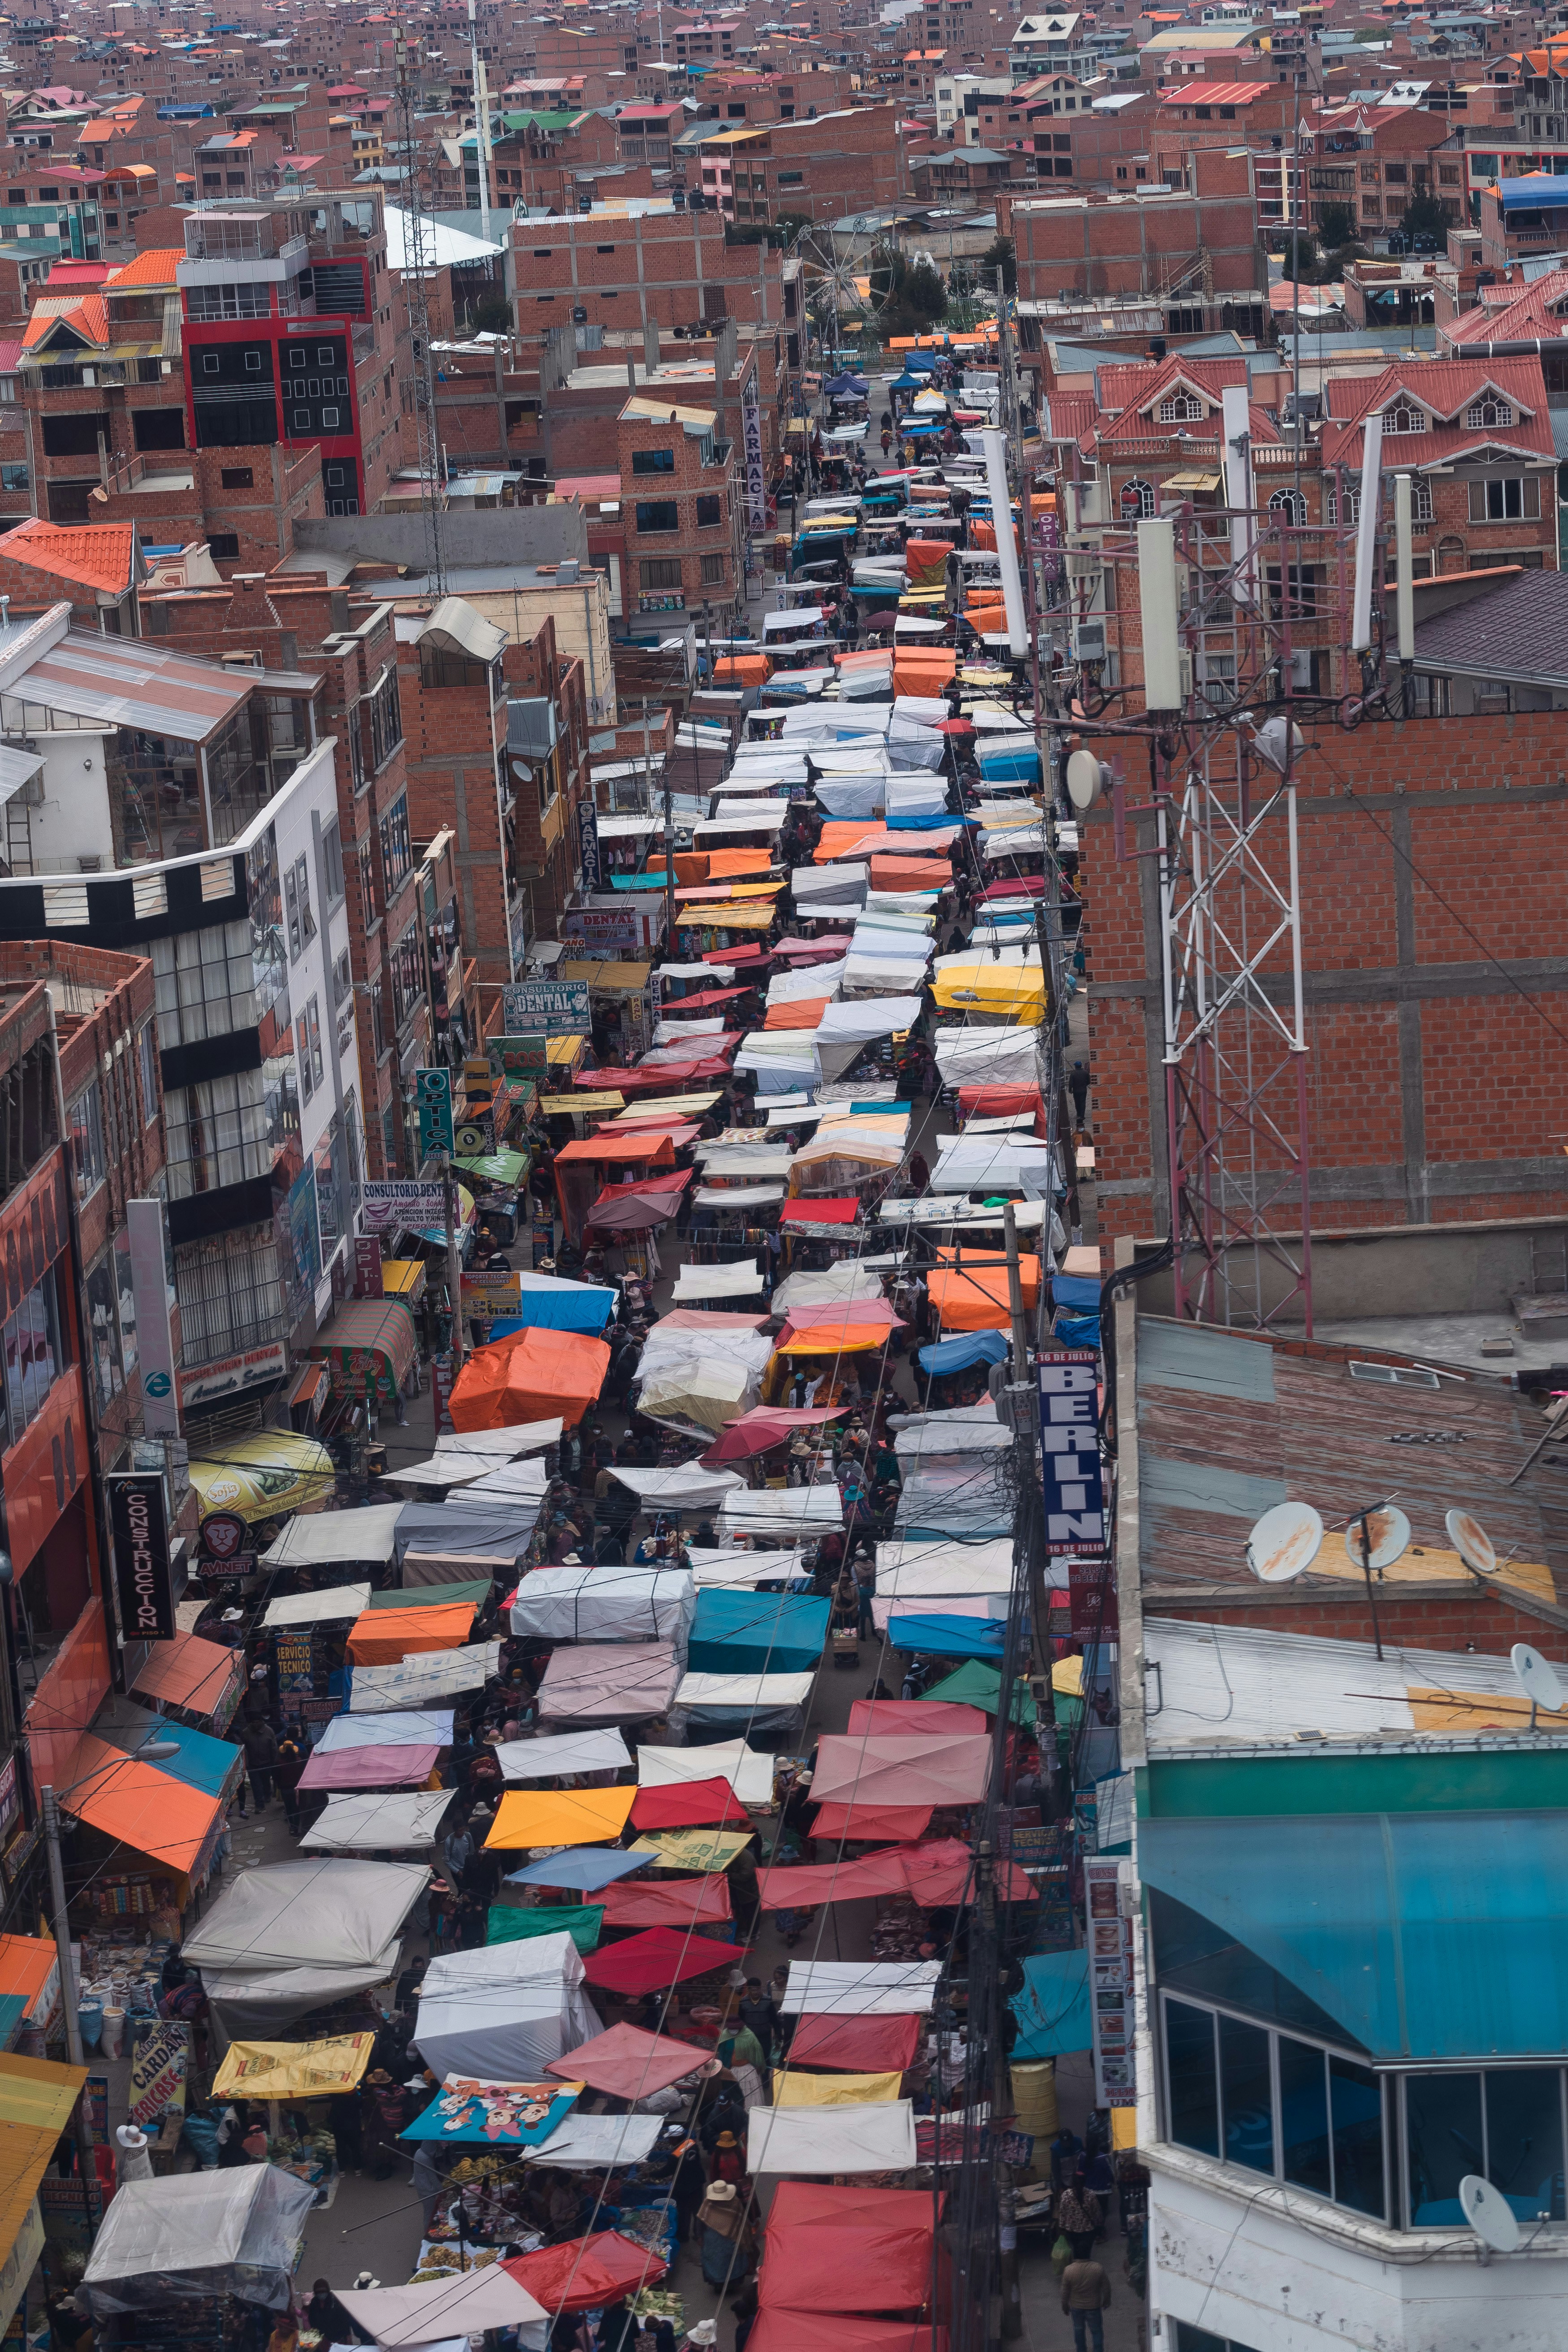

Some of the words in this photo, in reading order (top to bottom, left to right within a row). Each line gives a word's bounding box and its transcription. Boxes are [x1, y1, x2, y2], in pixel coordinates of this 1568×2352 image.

[745, 408, 762, 524] FARMACIA
[581, 817, 597, 884] FARMACIA
[583, 914, 634, 926] DENTAL
[505, 984, 585, 994] CONSULTORIO
[517, 993, 572, 1013] DENTAL
[505, 1050, 546, 1069] BOSS
[418, 1071, 450, 1152] OPTICA
[364, 1184, 419, 1198] CONSULTORIO
[421, 1183, 446, 1197] DENT
[181, 1356, 243, 1384] ONSULTORIO
[244, 1345, 282, 1365] DENTAL
[1039, 1353, 1051, 1361] 16
[1068, 1352, 1095, 1360] JULIO
[1040, 1366, 1103, 1540] BERLIN
[1077, 1543, 1105, 1551] JULIO
[199, 1559, 253, 1577] AVINET
[1070, 1574, 1081, 1583] DE
[277, 1645, 311, 1659] SERVICIO
[278, 1659, 311, 1674] TECNICO
